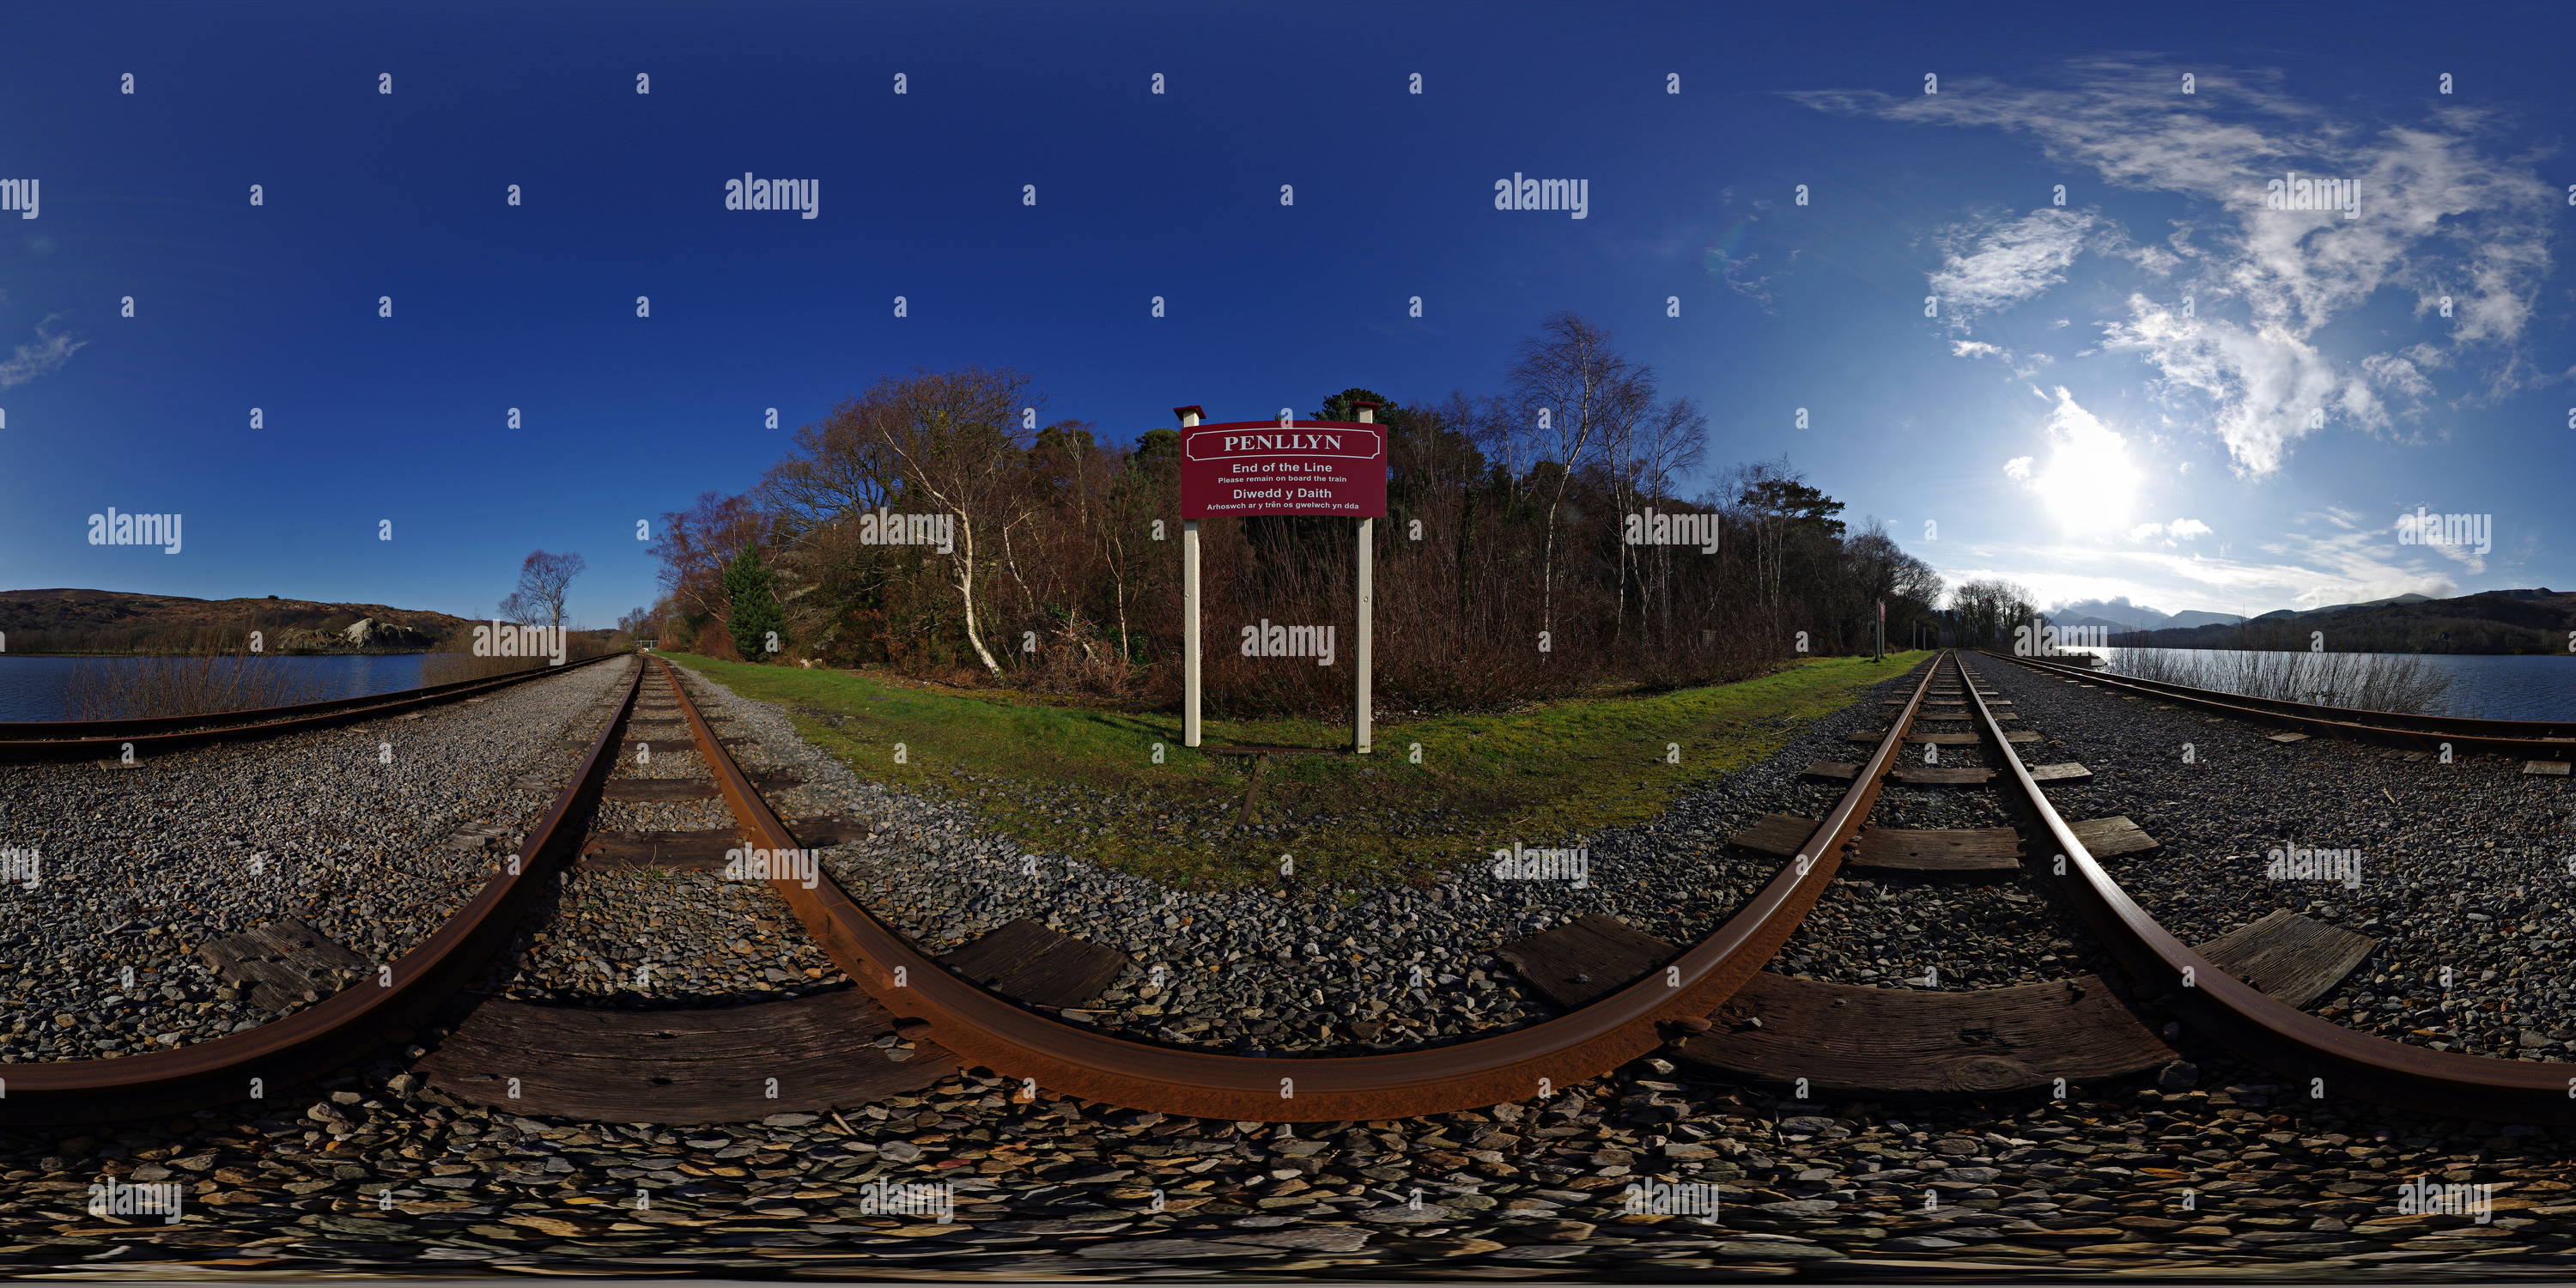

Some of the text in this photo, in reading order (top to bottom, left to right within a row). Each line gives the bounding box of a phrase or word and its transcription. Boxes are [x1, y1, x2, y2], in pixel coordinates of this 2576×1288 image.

[1224, 434, 1342, 452] PENLLYN
[1232, 462, 1333, 473] End of the Line
[1233, 488, 1332, 501] Diwedd y Daith
[1206, 502, 1246, 511] Arhoswch
